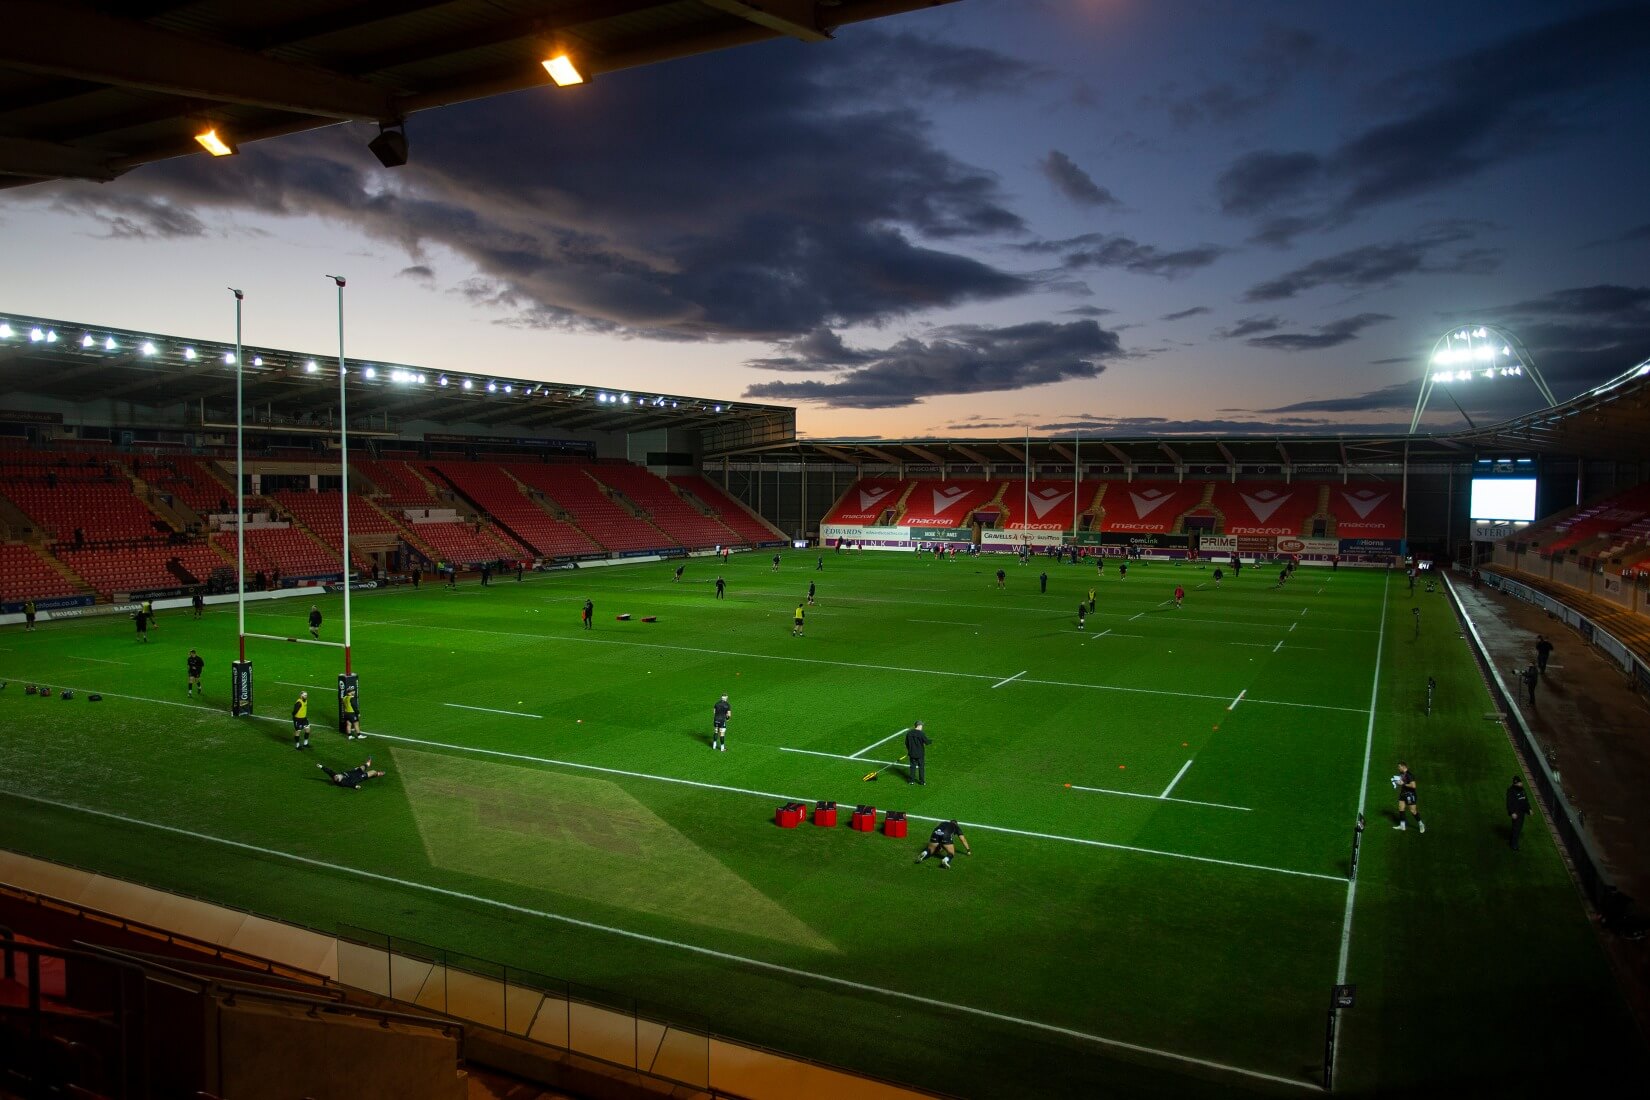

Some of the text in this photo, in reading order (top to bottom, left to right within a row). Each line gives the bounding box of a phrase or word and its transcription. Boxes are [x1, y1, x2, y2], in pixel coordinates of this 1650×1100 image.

[1010, 522, 1062, 530] macron
[1232, 526, 1291, 535] macron
[1201, 538, 1236, 547] PRIME
[241, 671, 249, 701] GUINNESS
